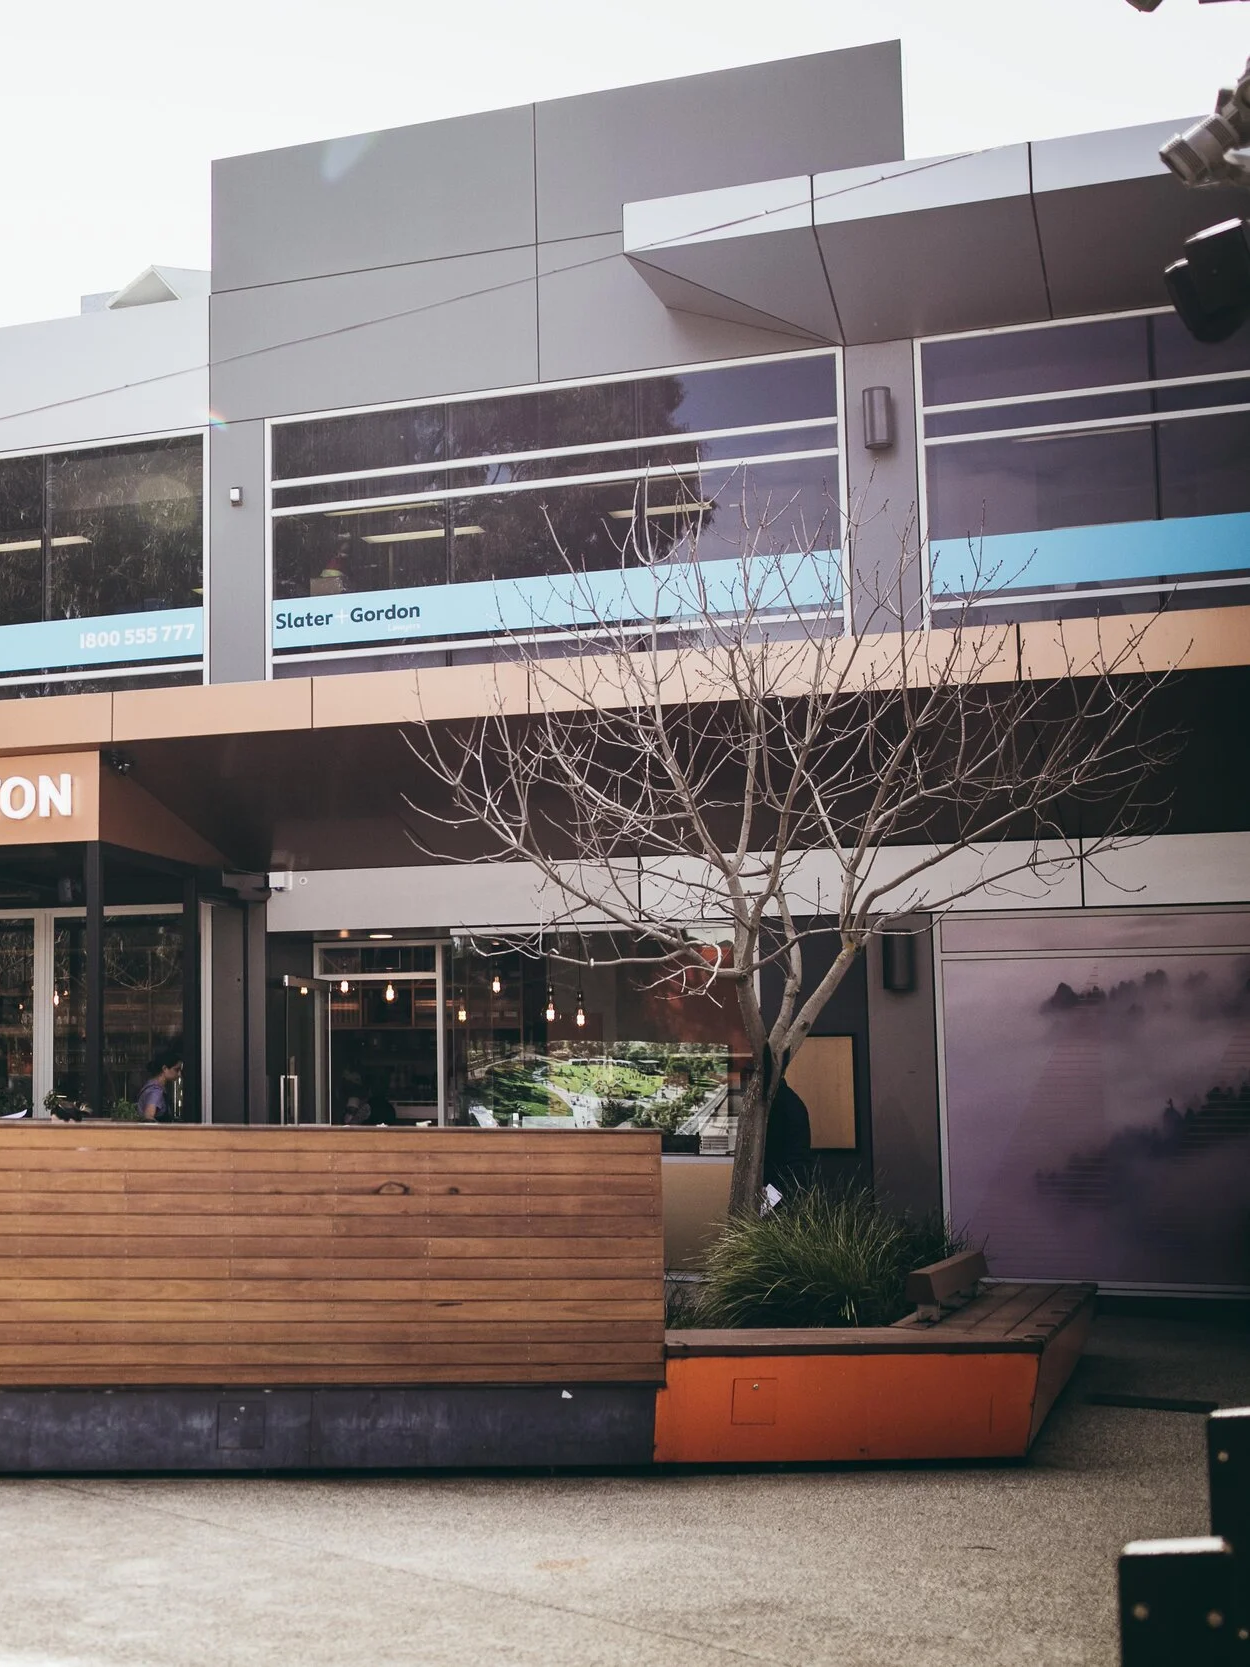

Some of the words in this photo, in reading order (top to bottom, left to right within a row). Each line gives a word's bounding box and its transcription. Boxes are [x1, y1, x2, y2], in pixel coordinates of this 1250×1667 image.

[276, 612, 333, 629] Slater
[350, 604, 420, 623] Gordon
[79, 630, 120, 649] 1800
[124, 626, 157, 645] 555
[161, 623, 195, 642] 777
